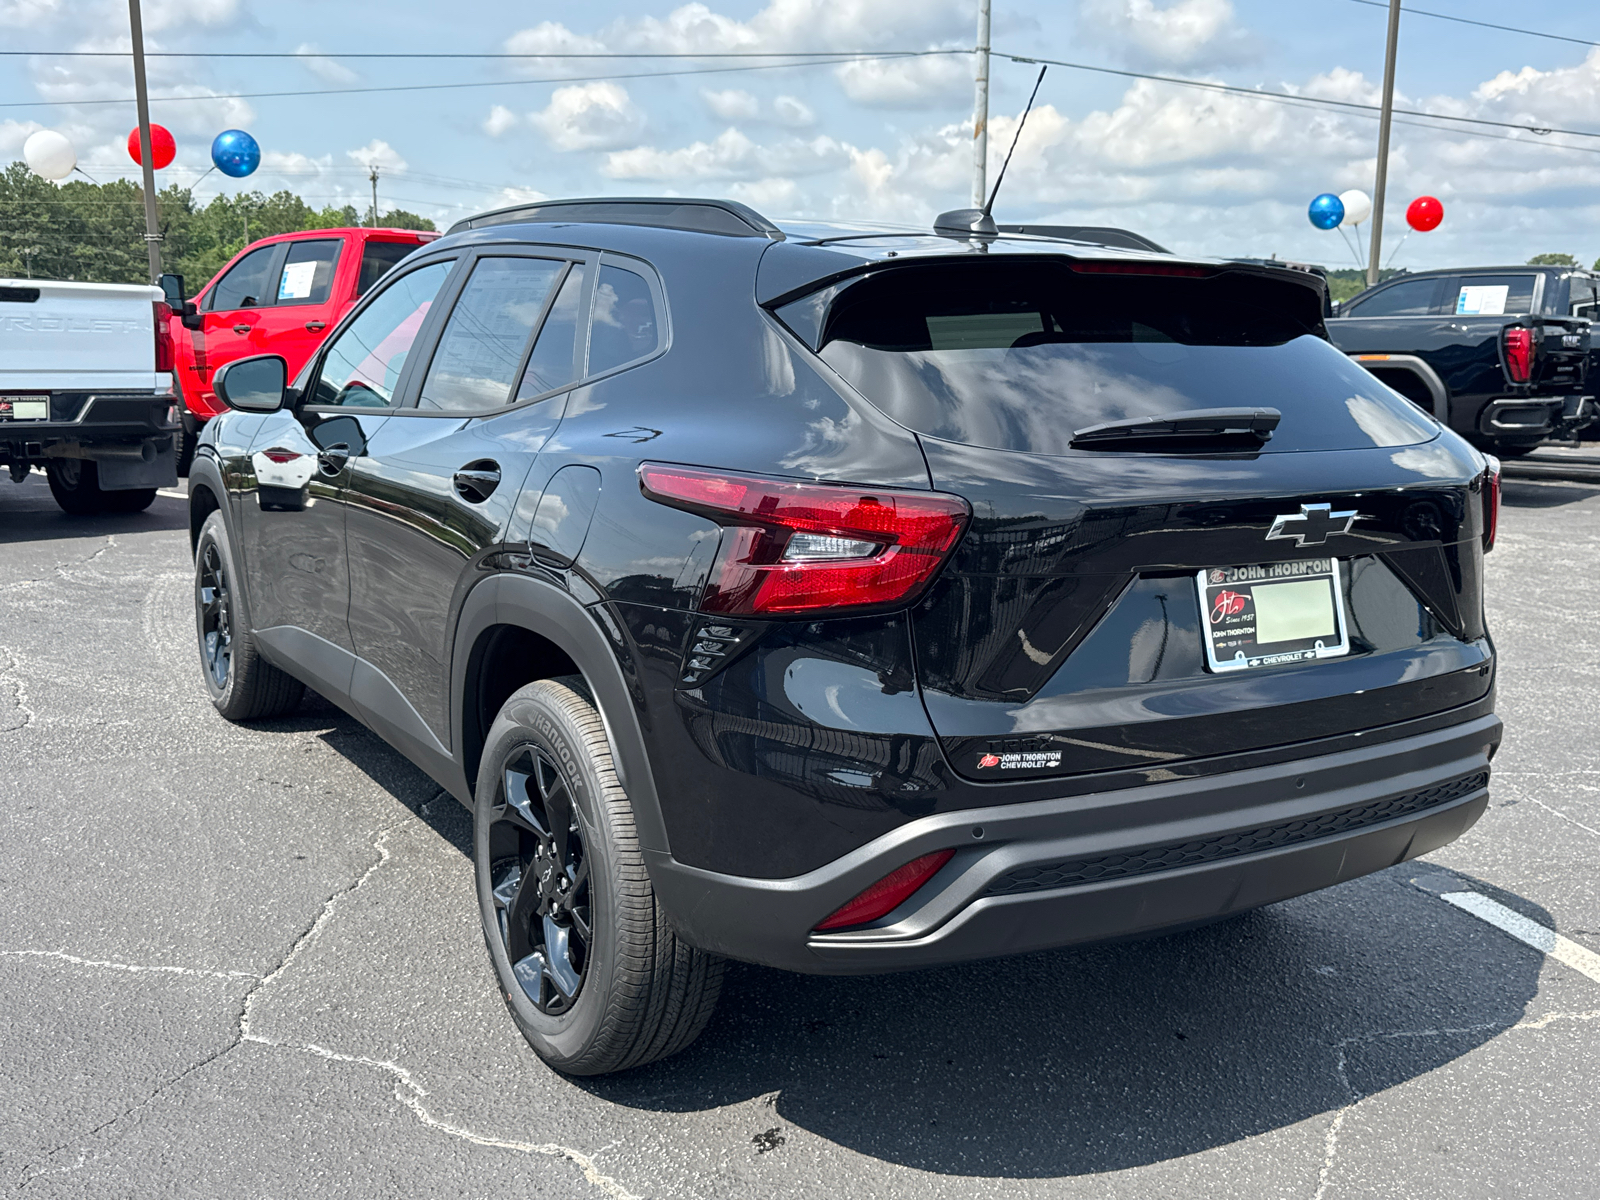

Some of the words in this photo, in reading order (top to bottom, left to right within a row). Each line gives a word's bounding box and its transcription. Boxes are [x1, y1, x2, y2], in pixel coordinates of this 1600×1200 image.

[1232, 567, 1266, 581] JOHN
[1225, 616, 1241, 624] Since
[1241, 613, 1255, 622] 1957
[1226, 627, 1255, 637] THORNTON
[1263, 653, 1302, 665] CHEVROLET
[534, 714, 583, 790] Hankook
[1001, 754, 1021, 762] JOHN
[1022, 752, 1061, 761] THORNTON
[1000, 761, 1046, 769] CHEVROLET
